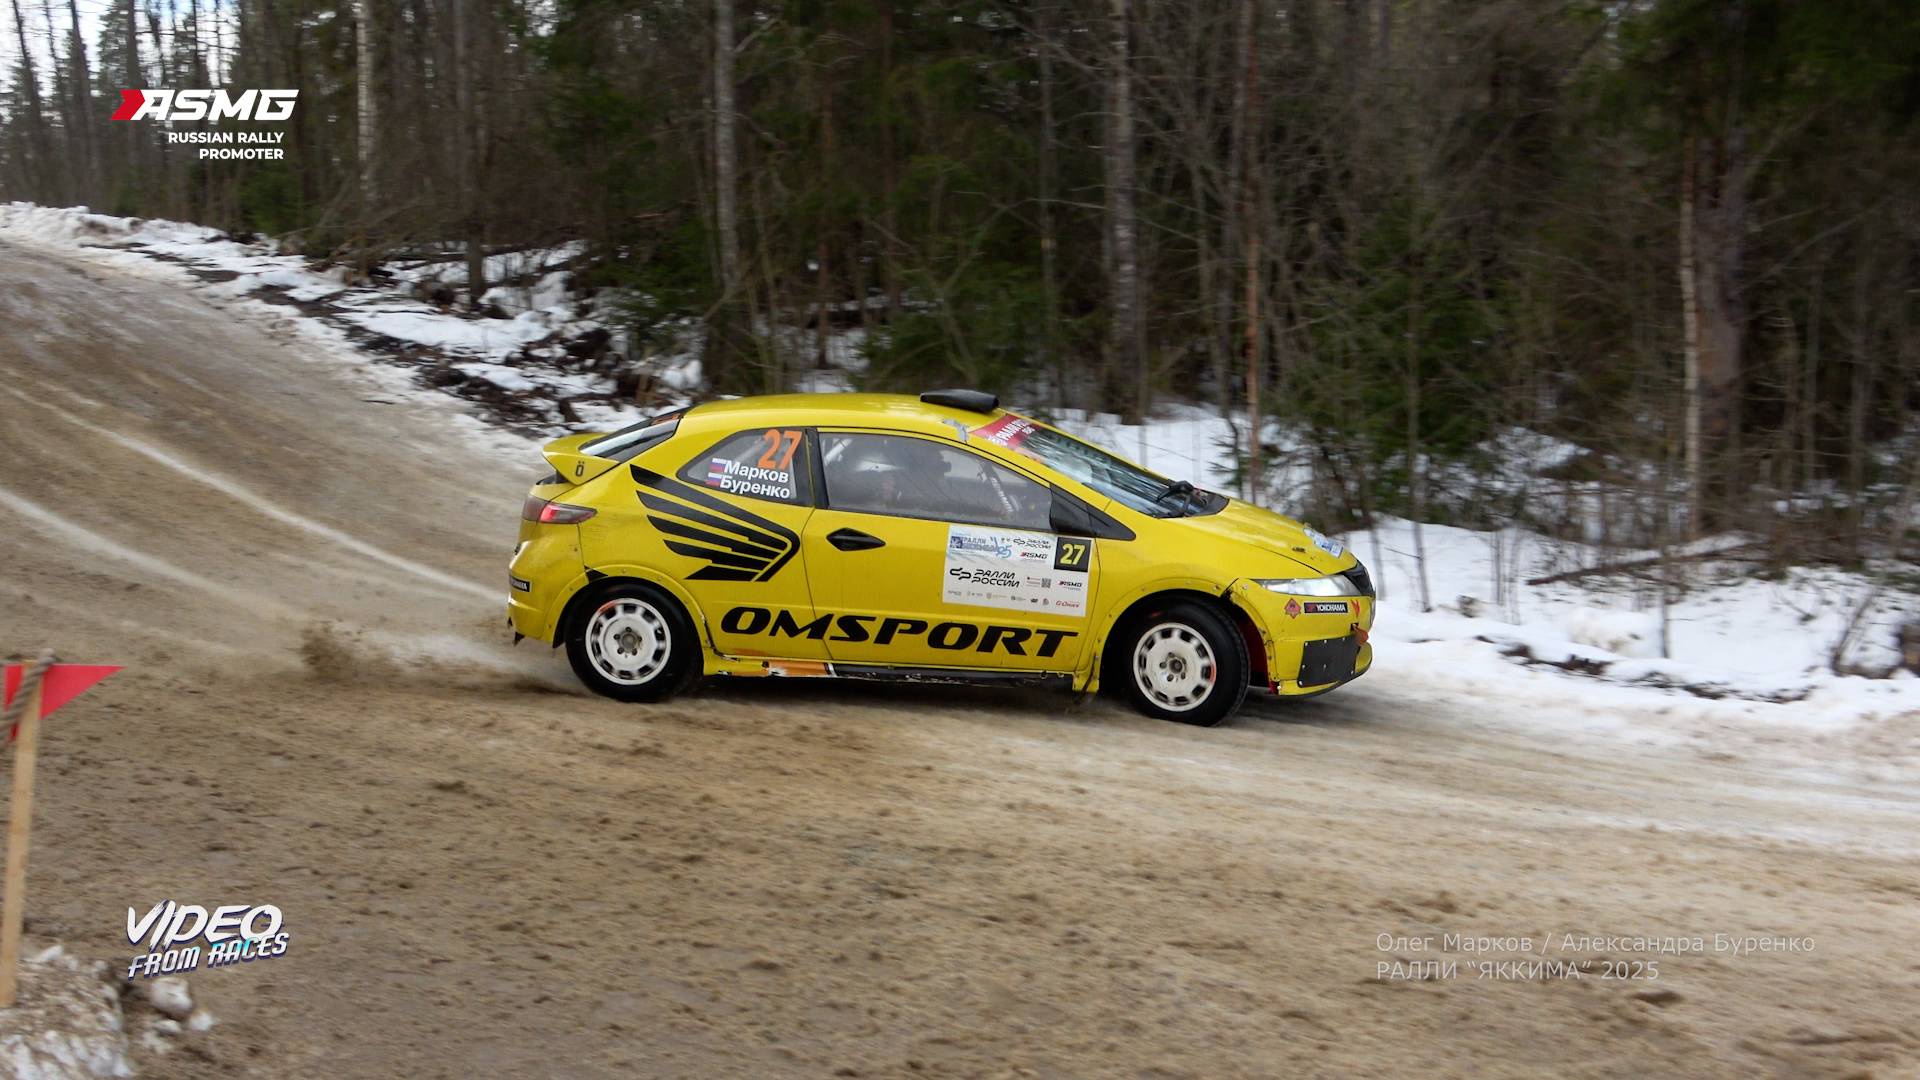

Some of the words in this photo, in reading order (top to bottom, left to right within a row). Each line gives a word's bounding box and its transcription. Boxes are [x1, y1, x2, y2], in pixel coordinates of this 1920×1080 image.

[757, 429, 802, 471] 27
[724, 460, 789, 483] Марков
[720, 474, 790, 499] Буренко
[1060, 543, 1086, 565] 27
[971, 576, 1020, 588] РОССИИ
[974, 569, 1016, 580] РАЛЛИ
[1316, 604, 1346, 612] YOKOHAMA
[720, 606, 1079, 658] OMSPORT
